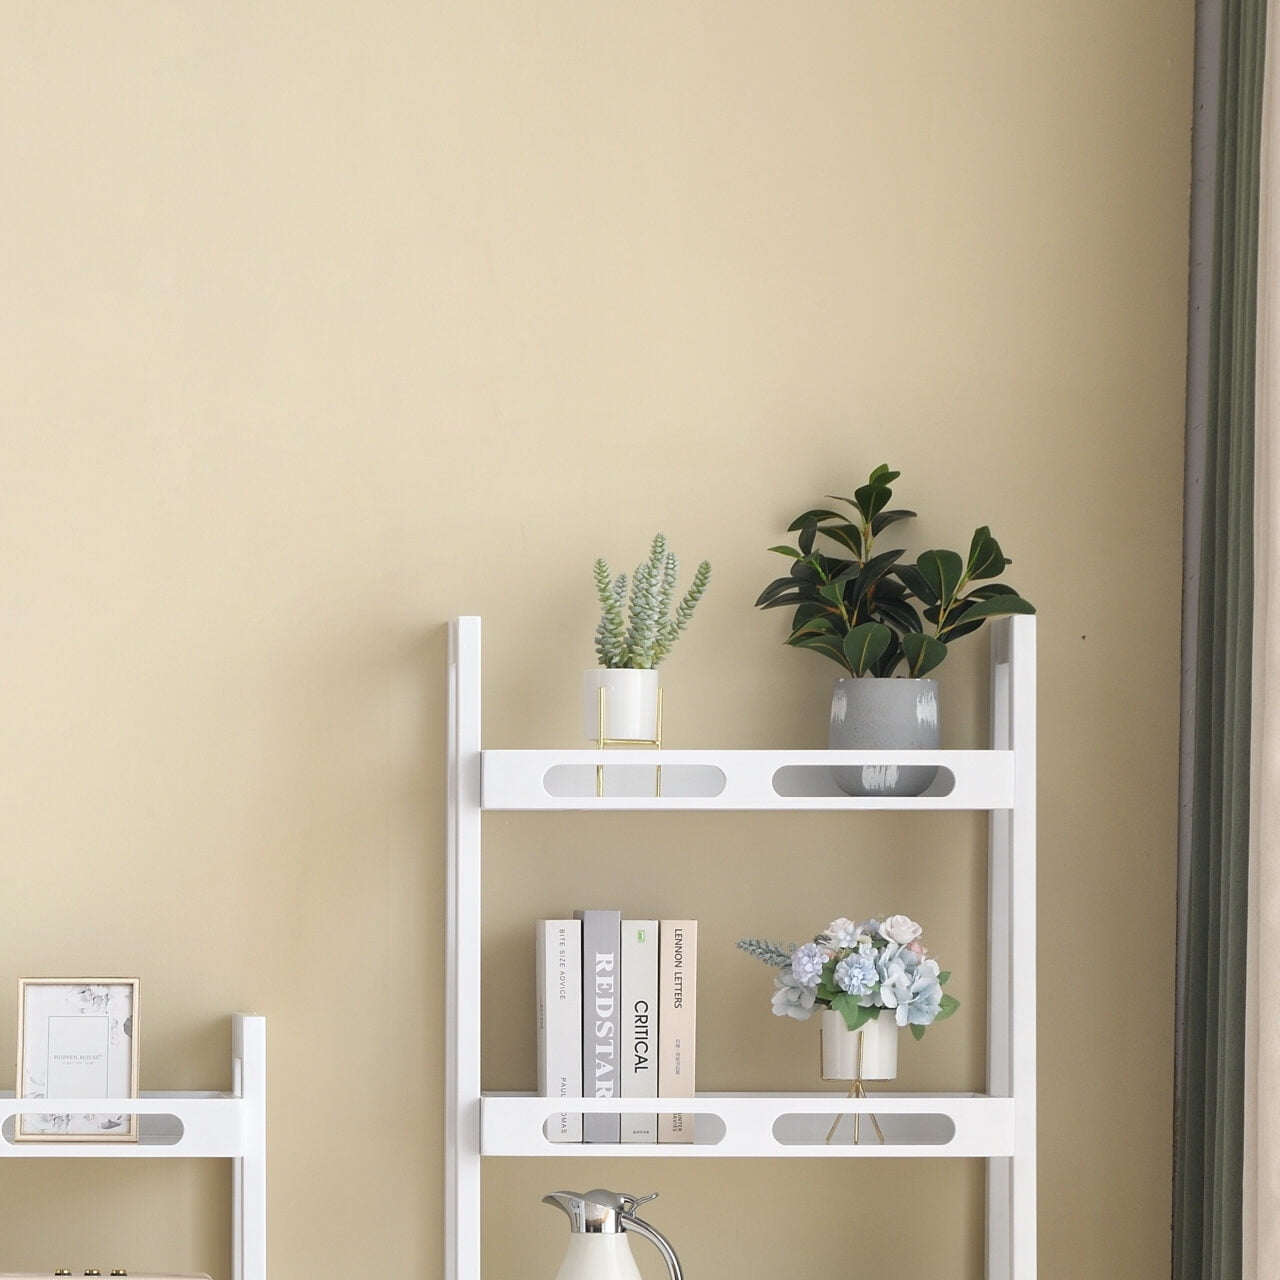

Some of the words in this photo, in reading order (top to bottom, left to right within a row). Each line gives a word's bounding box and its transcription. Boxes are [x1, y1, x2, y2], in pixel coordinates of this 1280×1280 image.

[674, 928, 683, 968] LENNON
[559, 970, 567, 1000] ADVICE
[673, 971, 683, 1009] LETTERS
[634, 1000, 649, 1074] CRITICAL
